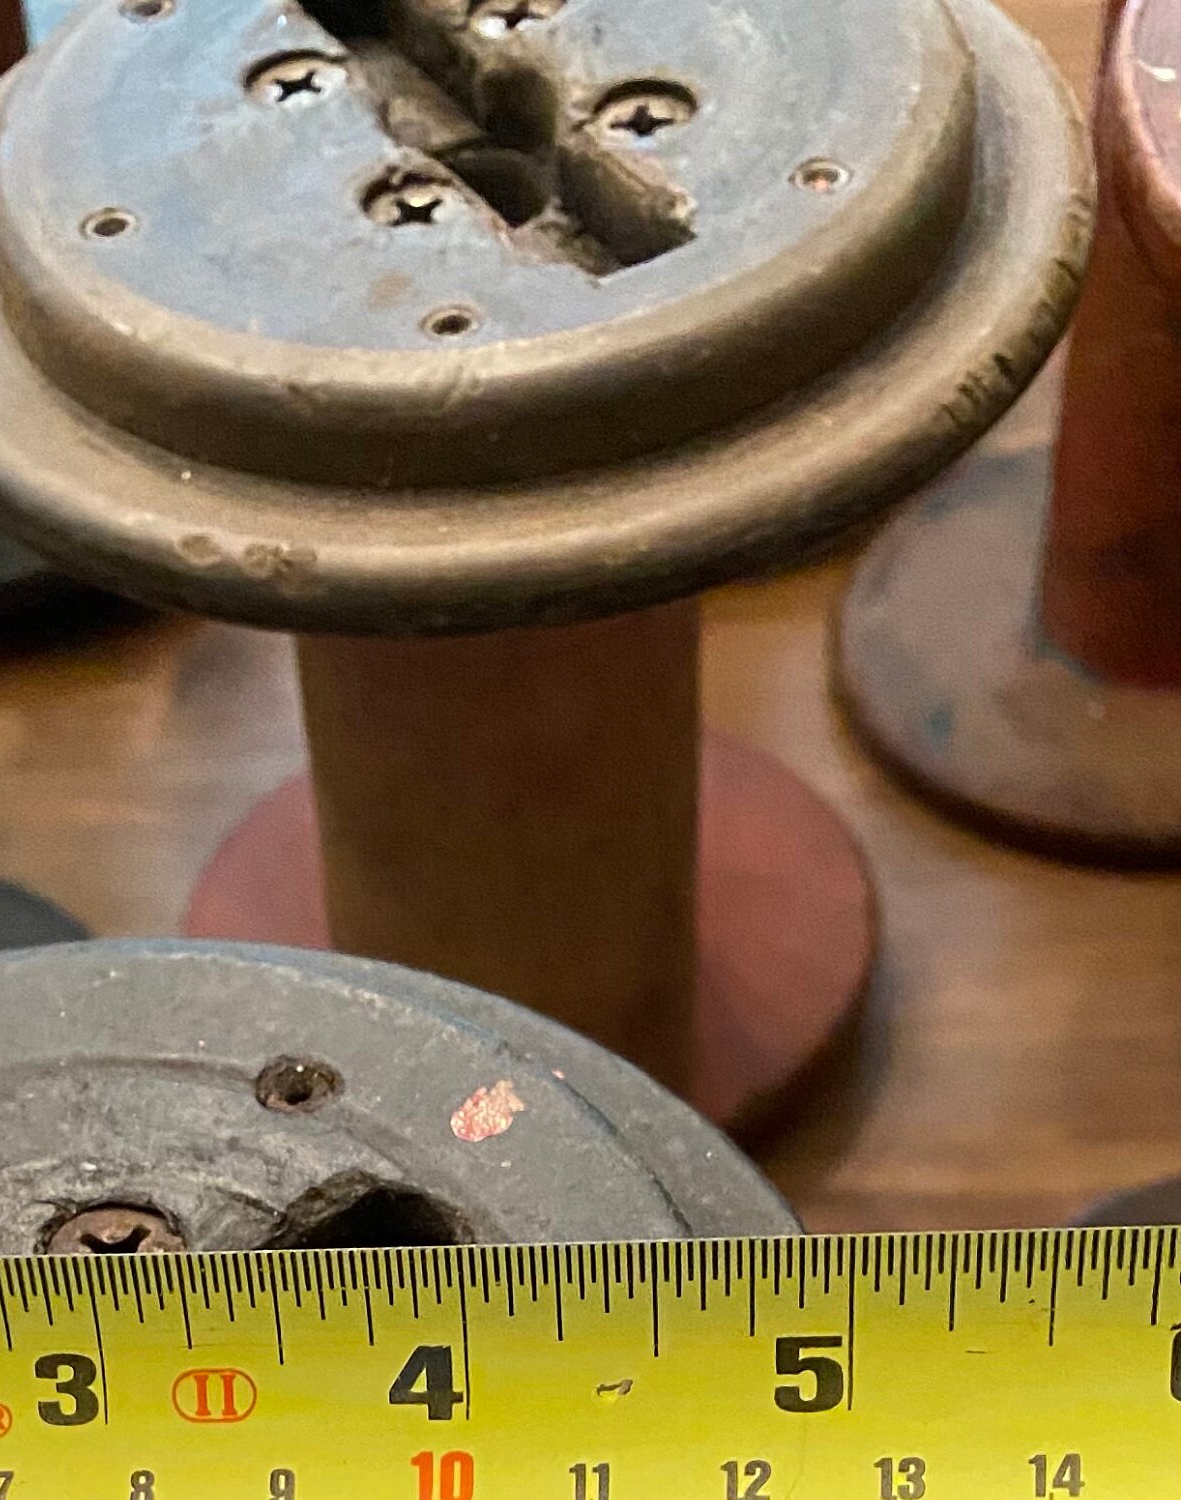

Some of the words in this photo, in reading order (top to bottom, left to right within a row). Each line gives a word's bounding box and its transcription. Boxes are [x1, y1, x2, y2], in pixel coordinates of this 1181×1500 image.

[34, 1353, 100, 1427] 3
[389, 1345, 465, 1421] 4
[774, 1335, 844, 1413] 5
[874, 1457, 927, 1500] 13
[1028, 1453, 1085, 1498] 14
